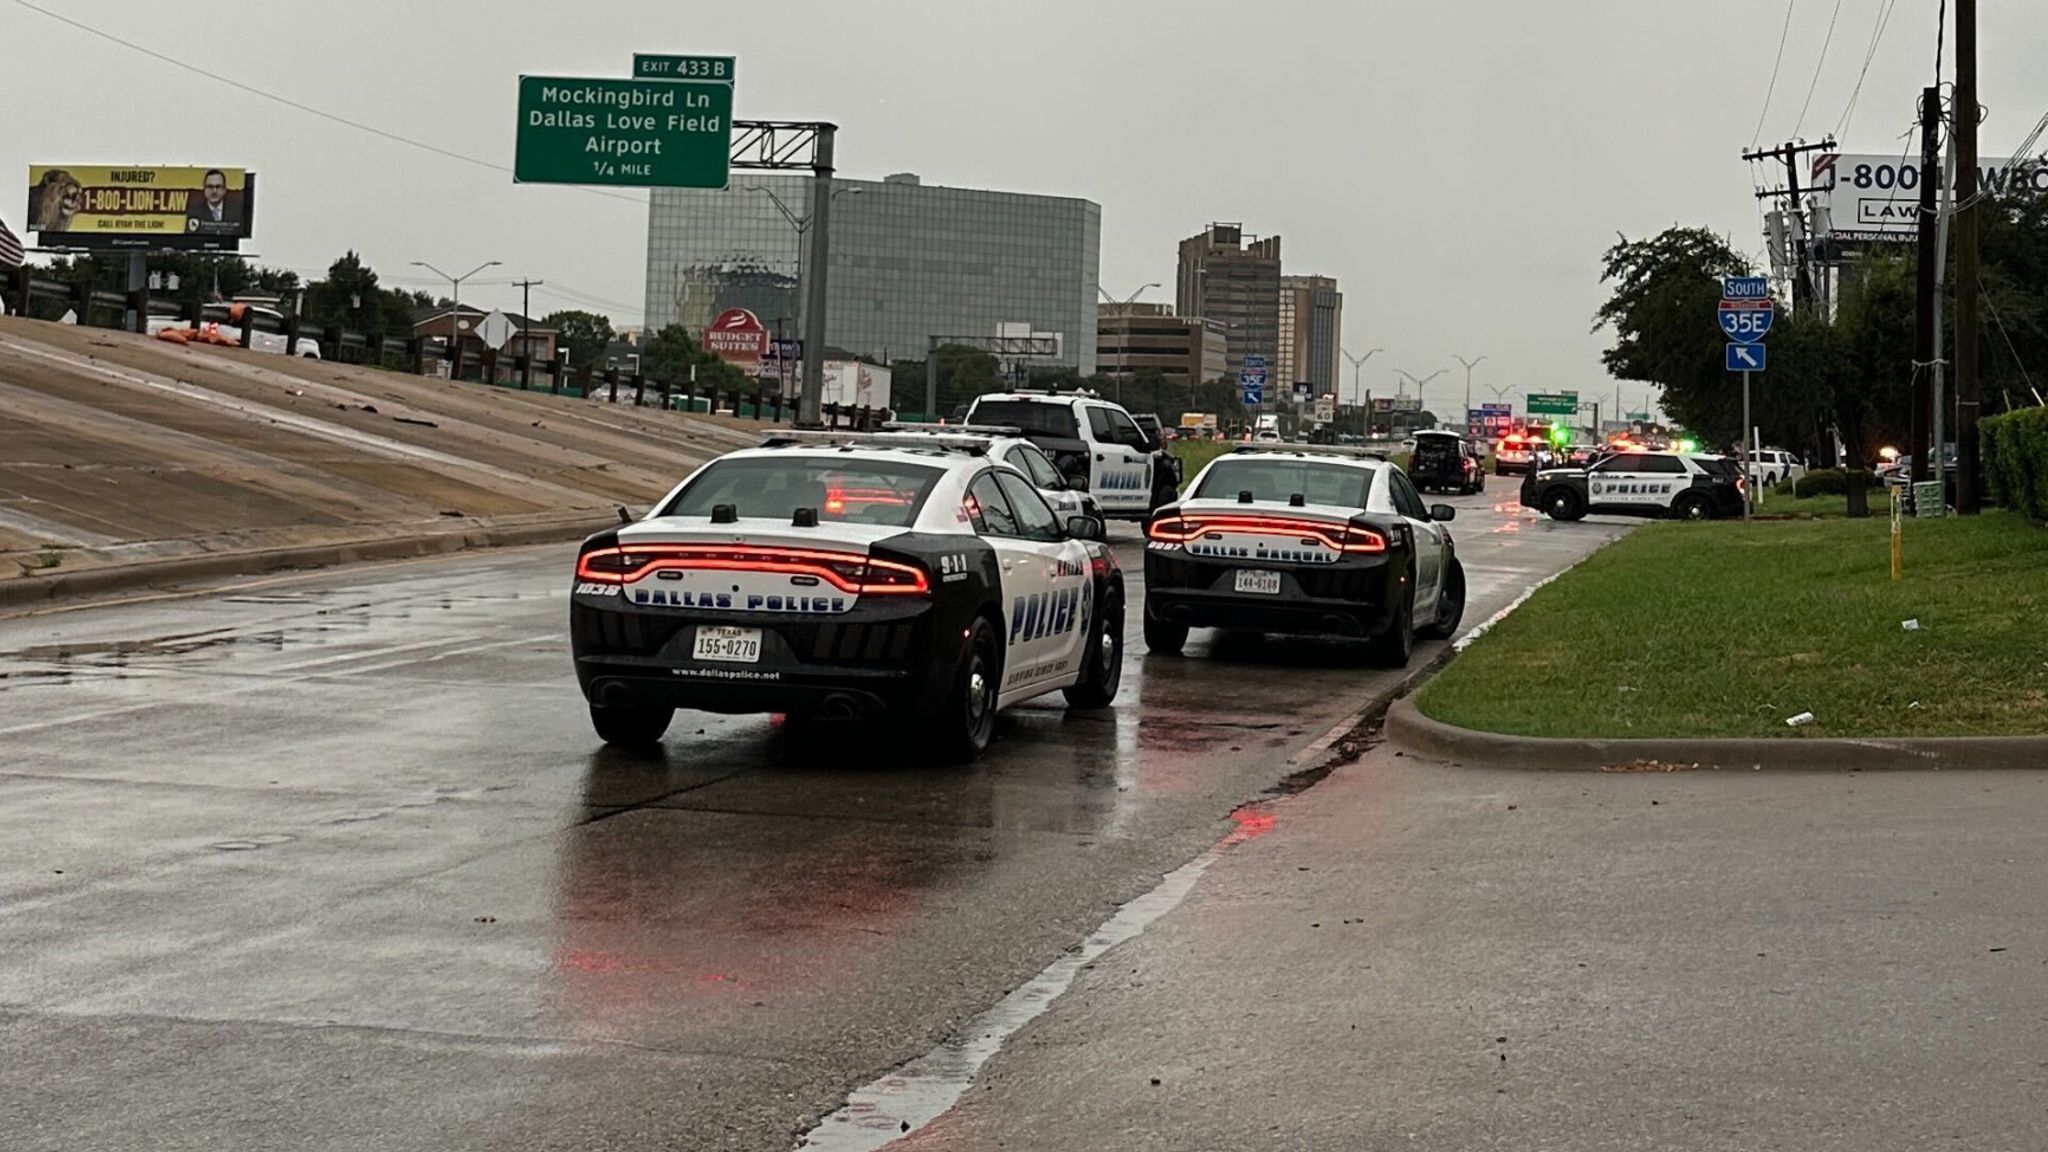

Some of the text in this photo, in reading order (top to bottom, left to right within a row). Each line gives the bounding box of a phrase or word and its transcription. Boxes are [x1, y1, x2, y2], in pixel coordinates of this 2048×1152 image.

[642, 61, 670, 72] EXIT
[542, 87, 710, 109] Mockingbird Ln
[530, 110, 720, 133] Dallas Love Field
[585, 137, 662, 157] Airport
[621, 164, 651, 175] MILE
[111, 171, 156, 183] INJURED?
[84, 190, 189, 211] 1-800-LION-LAW
[1727, 281, 1765, 295] SOUTH
[1725, 313, 1765, 333] 35E
[709, 332, 762, 340] BUDGET
[710, 342, 759, 350] SUITES
[1606, 483, 1672, 494] POLICE
[1191, 544, 1249, 557] DALLAS
[635, 589, 844, 612] DALLAS POLICE
[1008, 587, 1079, 646] POLICE
[717, 628, 742, 636] TEXAS
[672, 668, 780, 680] www.dallaspolice.net
